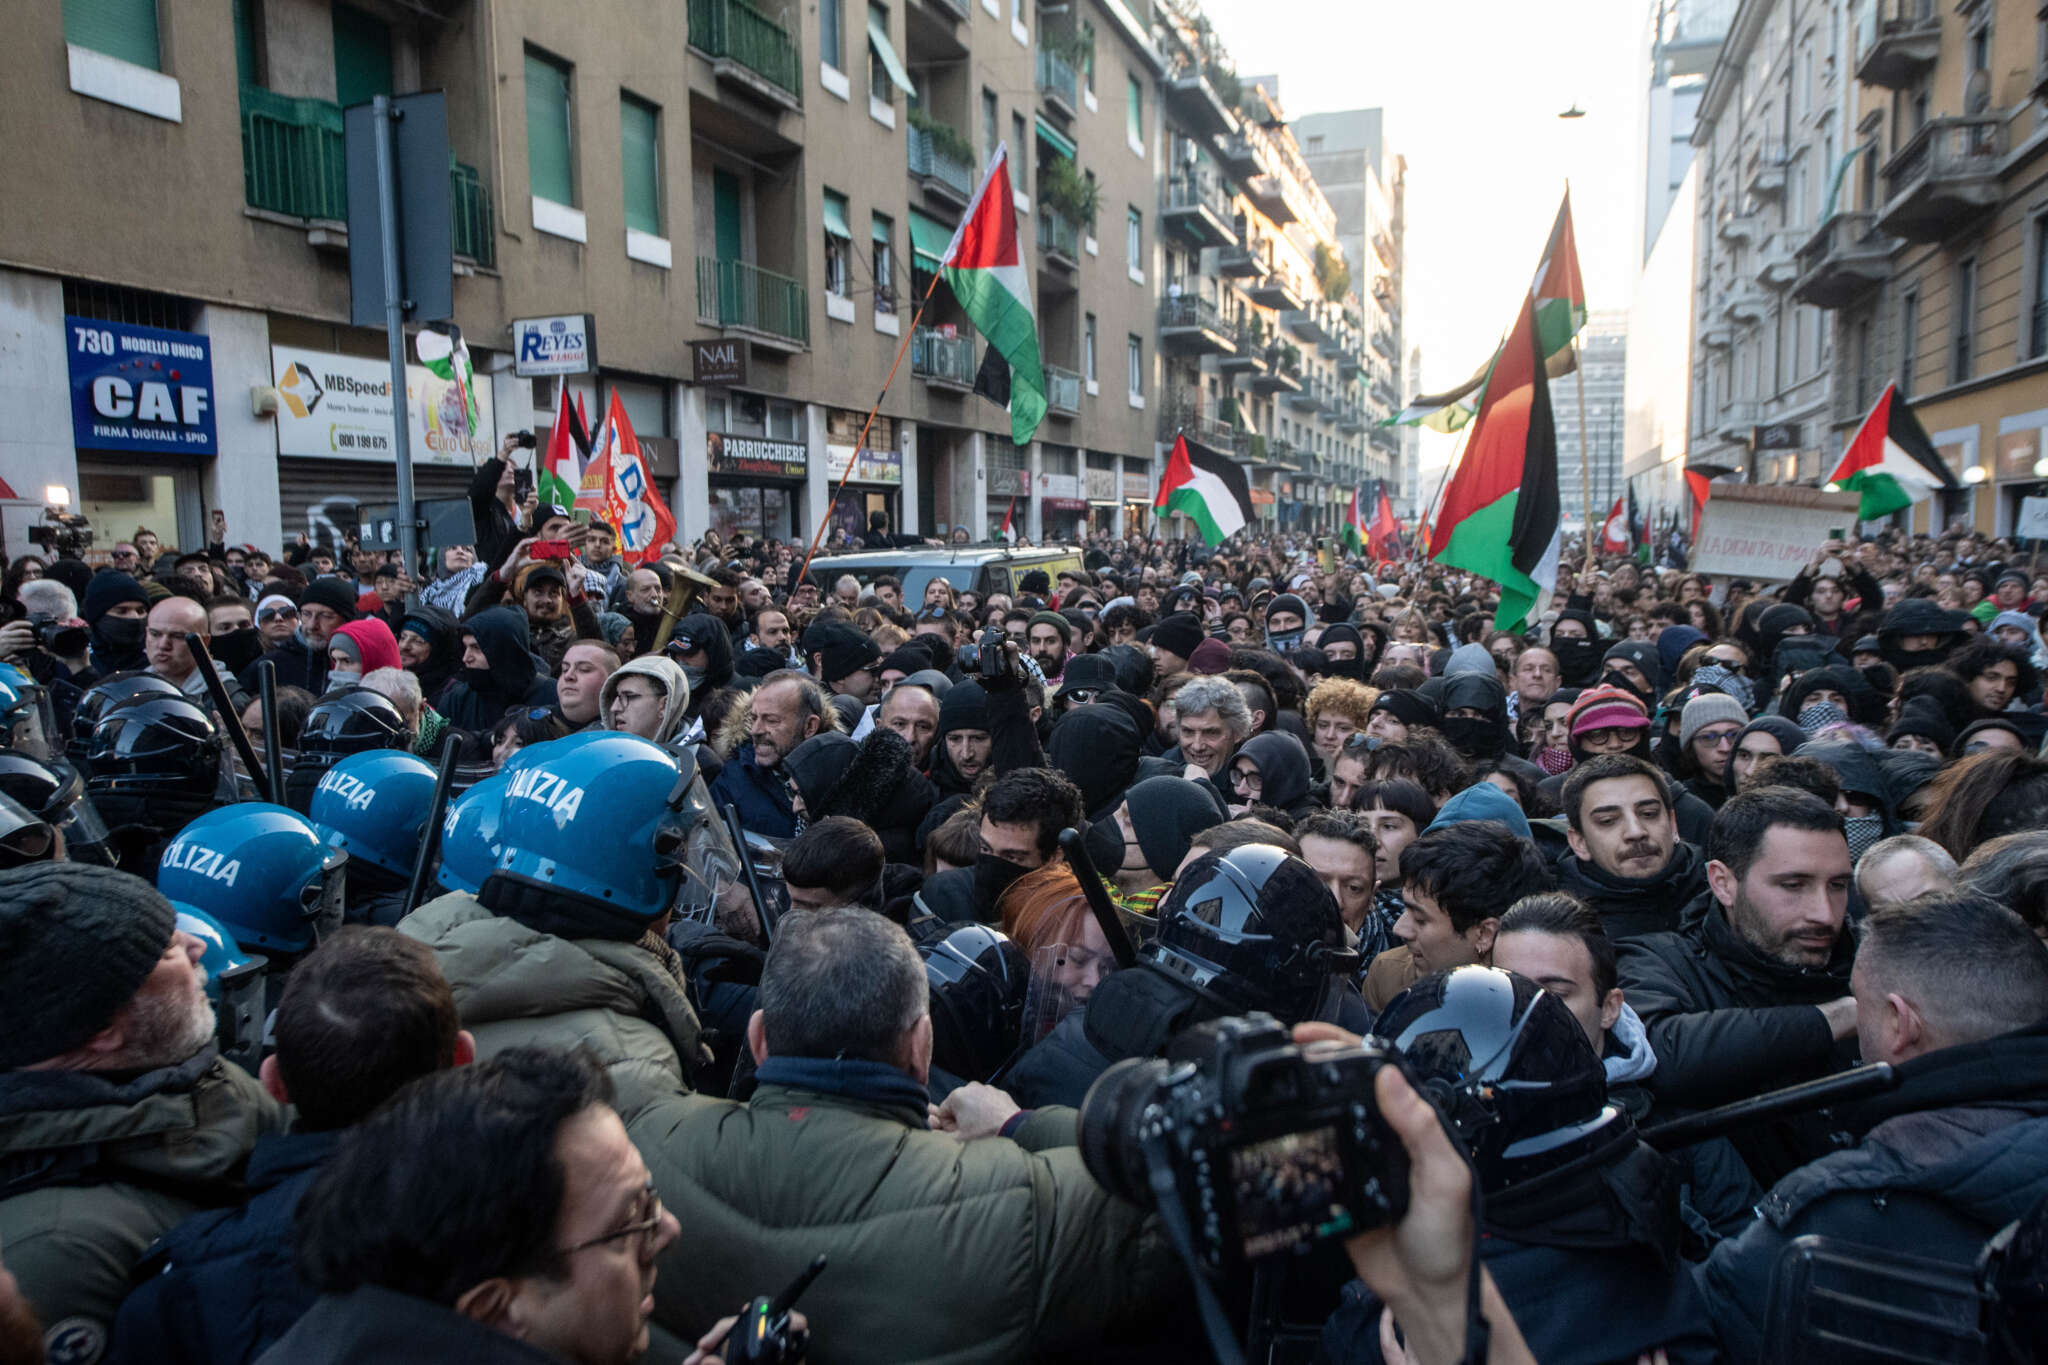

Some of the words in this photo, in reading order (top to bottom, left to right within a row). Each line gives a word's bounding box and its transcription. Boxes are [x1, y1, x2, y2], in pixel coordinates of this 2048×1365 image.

[74, 327, 115, 356] 730
[121, 336, 170, 356] MODELLO
[170, 343, 204, 360] UNICO
[520, 332, 584, 362] REYES
[700, 344, 738, 364] NAIL
[93, 376, 208, 425] CAF
[324, 373, 413, 400] MBSpeedFt
[93, 425, 129, 439] FIRMA
[131, 428, 177, 442] DIGITALE
[185, 433, 208, 443] SPID
[723, 438, 806, 463] PARRUCCHIERE
[318, 770, 376, 811] OLIZIA
[505, 768, 585, 822] OLIZIA
[161, 843, 241, 887] OLIZIA
